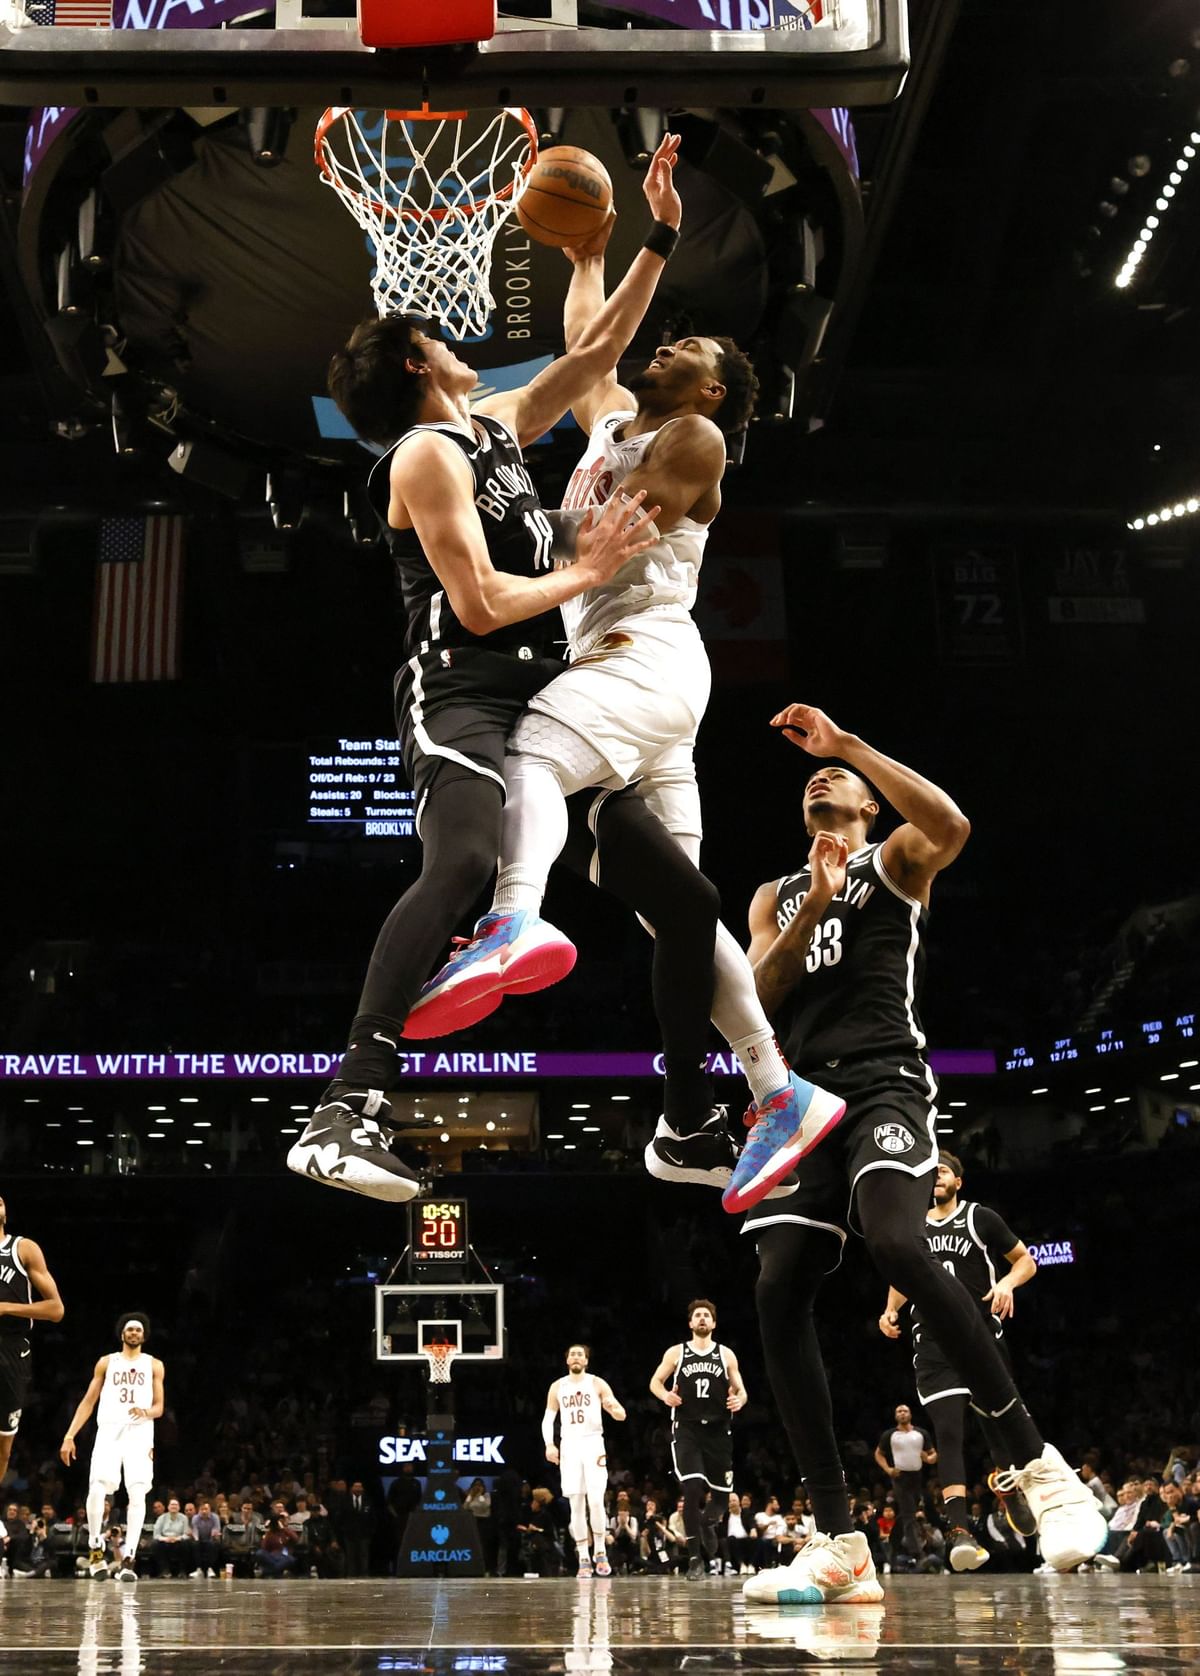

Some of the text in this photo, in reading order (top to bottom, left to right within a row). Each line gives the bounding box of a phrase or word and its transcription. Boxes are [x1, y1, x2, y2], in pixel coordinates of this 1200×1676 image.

[507, 209, 531, 339] BROOKLY
[954, 594, 1004, 624] 72
[339, 739, 401, 751] Team Stat
[309, 756, 399, 766] Total Rebounds: 32
[310, 773, 343, 783] Off/Def
[345, 773, 367, 783] Reb:
[383, 773, 395, 783] 23
[310, 790, 362, 800] Assists: 20
[373, 790, 409, 800] Blocks:
[310, 807, 351, 817] Steals: 5
[365, 822, 412, 835] BROOKLYN
[805, 917, 843, 973] 33
[1142, 1021, 1163, 1032] REB
[1176, 1014, 1195, 1026] AST
[1101, 1030, 1113, 1040] FT
[1148, 1034, 1160, 1044] 30
[1055, 1038, 1071, 1049] 3PT
[1013, 1048, 1026, 1057] FG
[96, 1054, 165, 1074] WITH
[174, 1054, 225, 1074] THE
[433, 1052, 537, 1073] AIRLINE
[877, 1126, 913, 1146] NETS
[422, 1204, 460, 1220] 10:54
[422, 1220, 456, 1246] 20
[926, 1234, 973, 1257] OKLYN
[1027, 1241, 1073, 1260] QATAR
[428, 1251, 464, 1259] TISSOT
[1038, 1254, 1074, 1266] AIRWAYS
[681, 1362, 723, 1378] BROOKLYN
[113, 1370, 145, 1386] CAVS
[695, 1378, 710, 1398] 12
[119, 1388, 135, 1404] 31
[562, 1393, 591, 1408] CAVS
[570, 1410, 585, 1424] 16
[379, 1436, 505, 1464] SEAEEK
[410, 1549, 472, 1562] BARCLAYS
